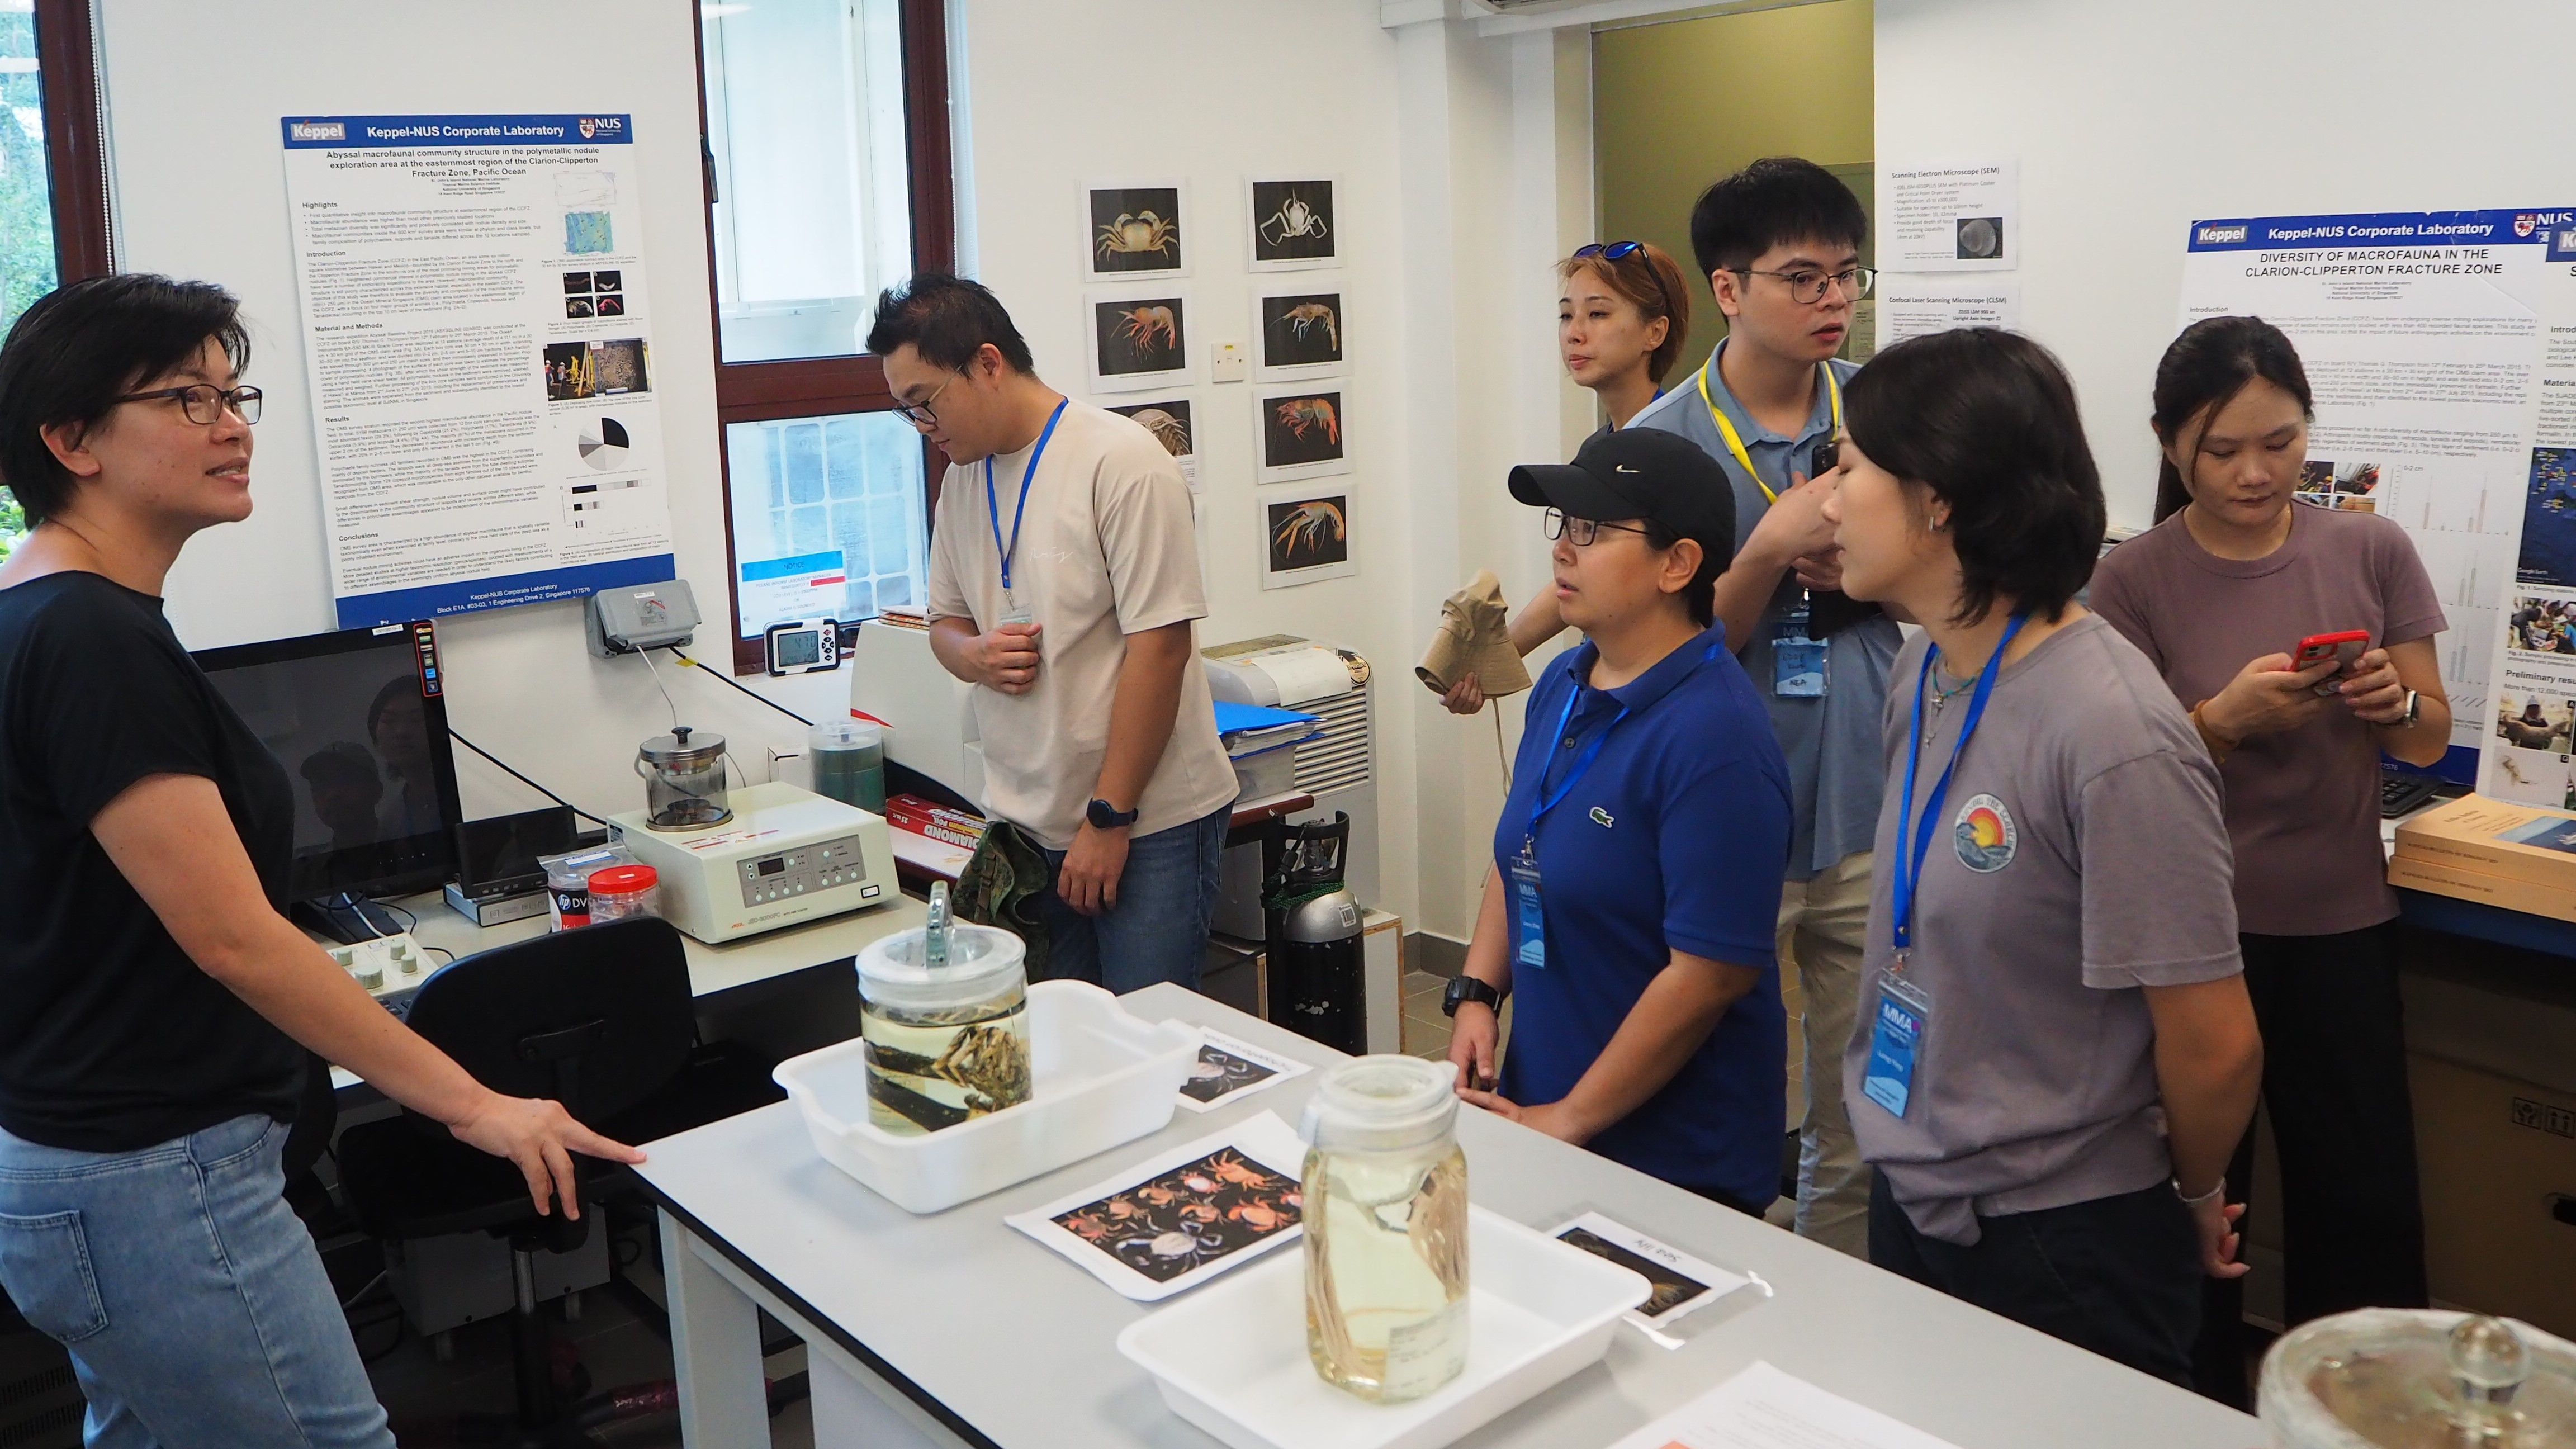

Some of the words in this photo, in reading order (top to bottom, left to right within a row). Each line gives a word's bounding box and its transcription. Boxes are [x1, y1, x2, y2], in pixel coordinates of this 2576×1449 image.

[595, 118, 621, 129] NUS
[294, 125, 343, 139] Keppel
[367, 126, 440, 139] Keppel-NUS
[443, 126, 501, 138] Corporate
[504, 125, 564, 138] Laboratory
[326, 150, 361, 160] Abyssal
[416, 149, 462, 158] community
[526, 148, 572, 157] polymetallic
[330, 160, 378, 170] exploration
[477, 158, 503, 167] region
[529, 157, 598, 166] Clarion-Clipperton
[448, 169, 471, 178] Zone,
[1891, 172, 1916, 180] Scanning
[1943, 169, 1979, 177] Microscope
[302, 201, 338, 210] Highlights
[2537, 212, 2573, 225] NUS
[2200, 227, 2246, 243] Keppel
[2268, 226, 2344, 241] Keppel-NUS
[2347, 225, 2414, 238] Corporate
[2418, 223, 2494, 237] Laboratory
[2260, 252, 2324, 263] DIVERSITY
[2327, 252, 2344, 261] OF
[2347, 250, 2441, 261] MACROFAUNA
[2445, 250, 2458, 259] IN
[2463, 249, 2489, 259] THE
[2246, 266, 2384, 277] CLARION-CLIPPERTON
[2388, 264, 2461, 274] FRACTURE
[2464, 264, 2503, 274] ZONE
[339, 532, 379, 542] Conclusions
[784, 561, 804, 570] NOTICE
[470, 591, 503, 602] Keppel-NUS
[503, 588, 530, 597] Corporate
[530, 584, 558, 594] Laboratory
[493, 596, 524, 607] Engineering
[546, 590, 571, 599] Singapore
[2506, 669, 2555, 684] Preliminary
[932, 815, 948, 827] FOIL
[558, 896, 570, 910] hp
[572, 898, 588, 908] DV
[1883, 1003, 1913, 1034] MMA
